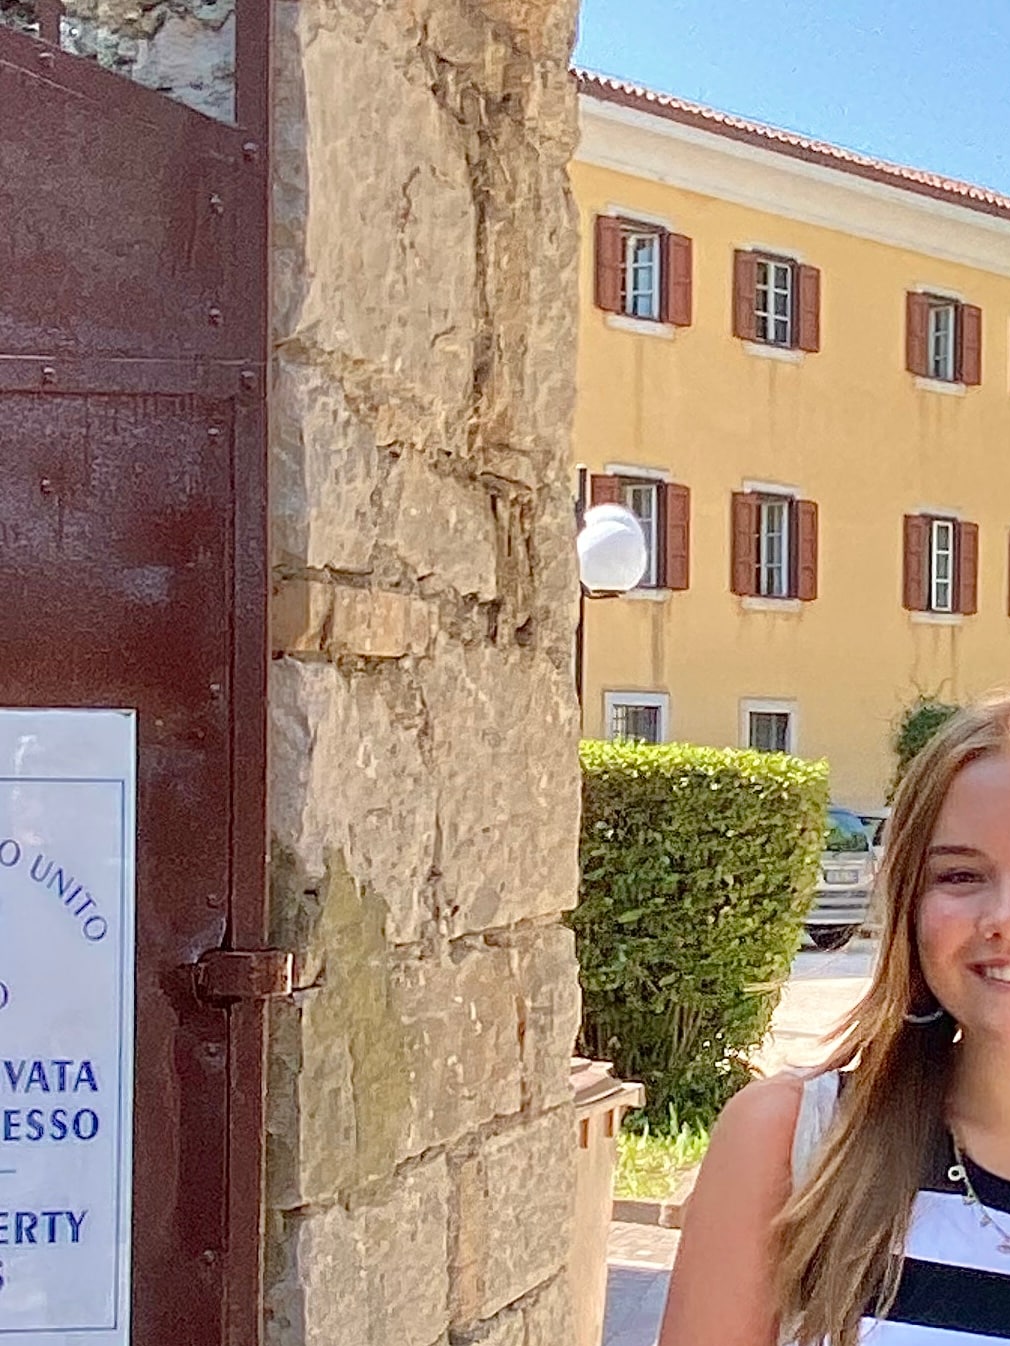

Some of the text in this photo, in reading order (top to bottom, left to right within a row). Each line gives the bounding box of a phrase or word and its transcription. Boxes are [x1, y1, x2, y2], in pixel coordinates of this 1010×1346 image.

[30, 854, 107, 942] UNITO
[4, 1060, 98, 1093] VATA
[4, 1109, 99, 1141] ESSO
